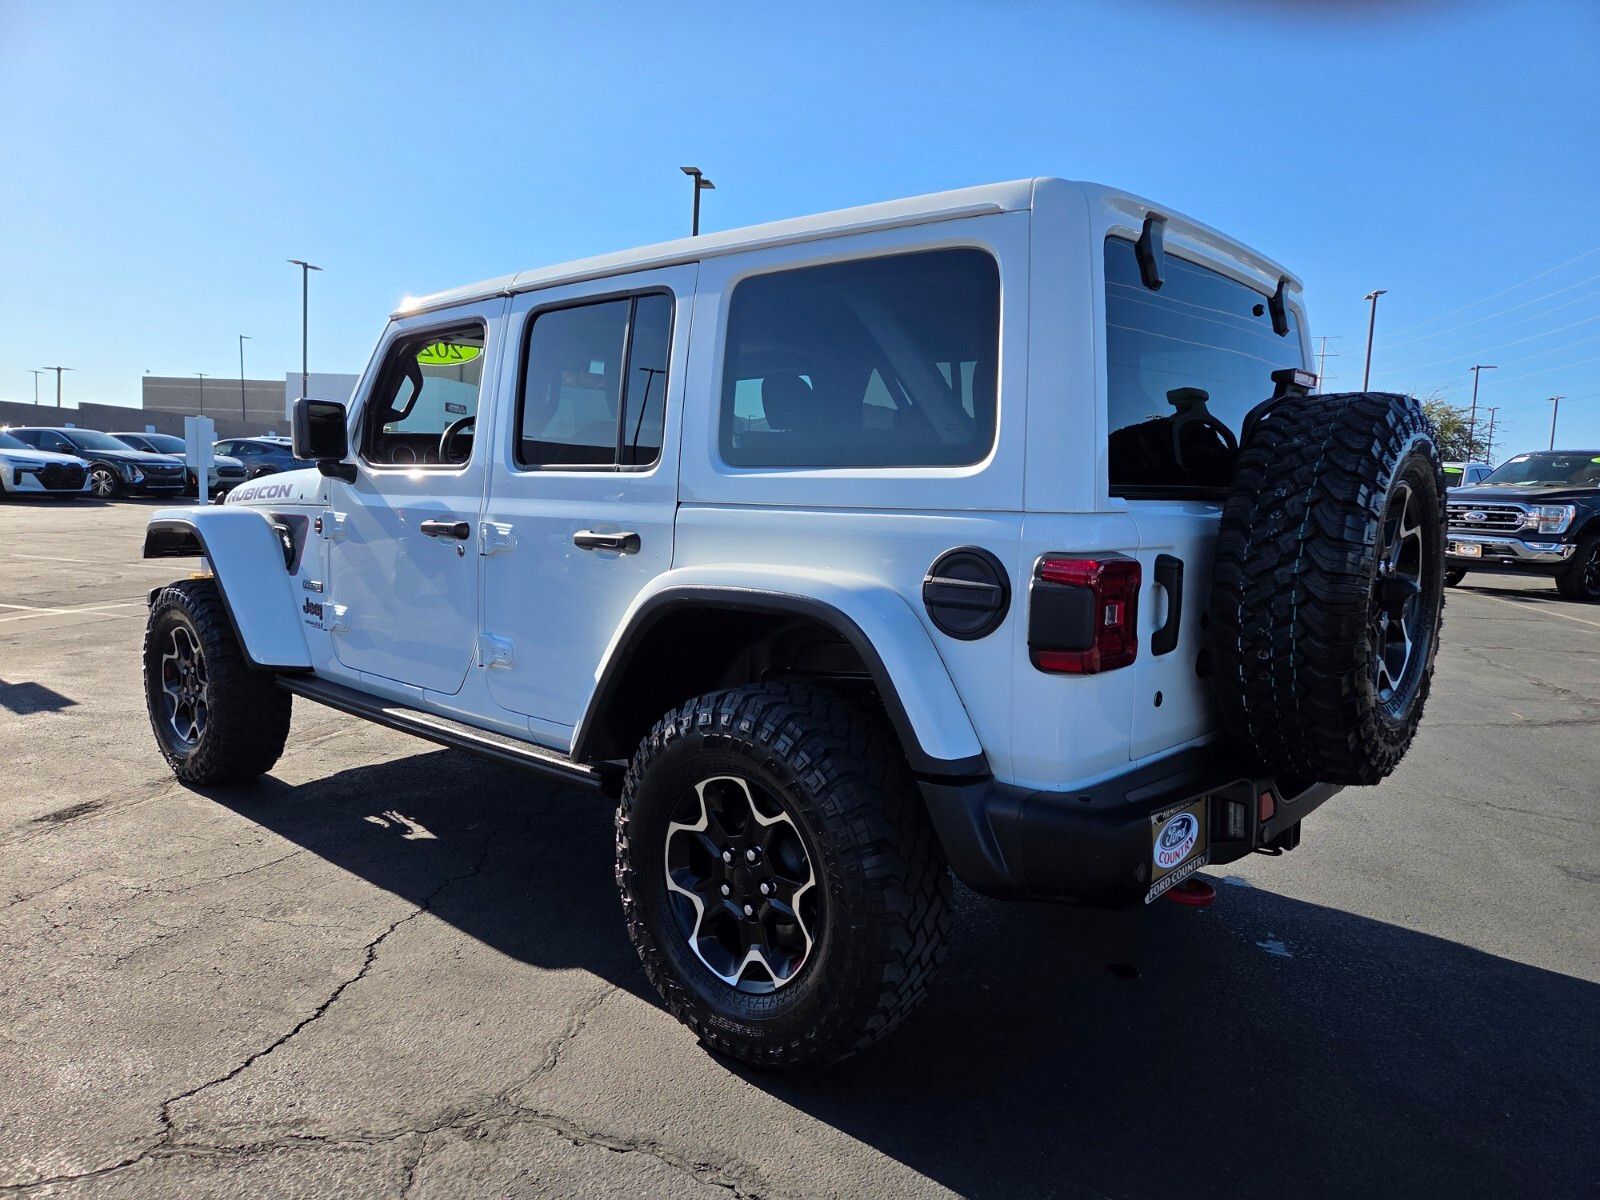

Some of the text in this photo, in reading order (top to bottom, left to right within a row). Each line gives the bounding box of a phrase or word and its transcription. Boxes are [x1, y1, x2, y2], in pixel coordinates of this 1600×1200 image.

[227, 483, 294, 503] RUBICON
[1165, 820, 1188, 847] Ford
[1159, 836, 1194, 864] COUNTRY
[1150, 855, 1206, 899] FORD COUNTRY
